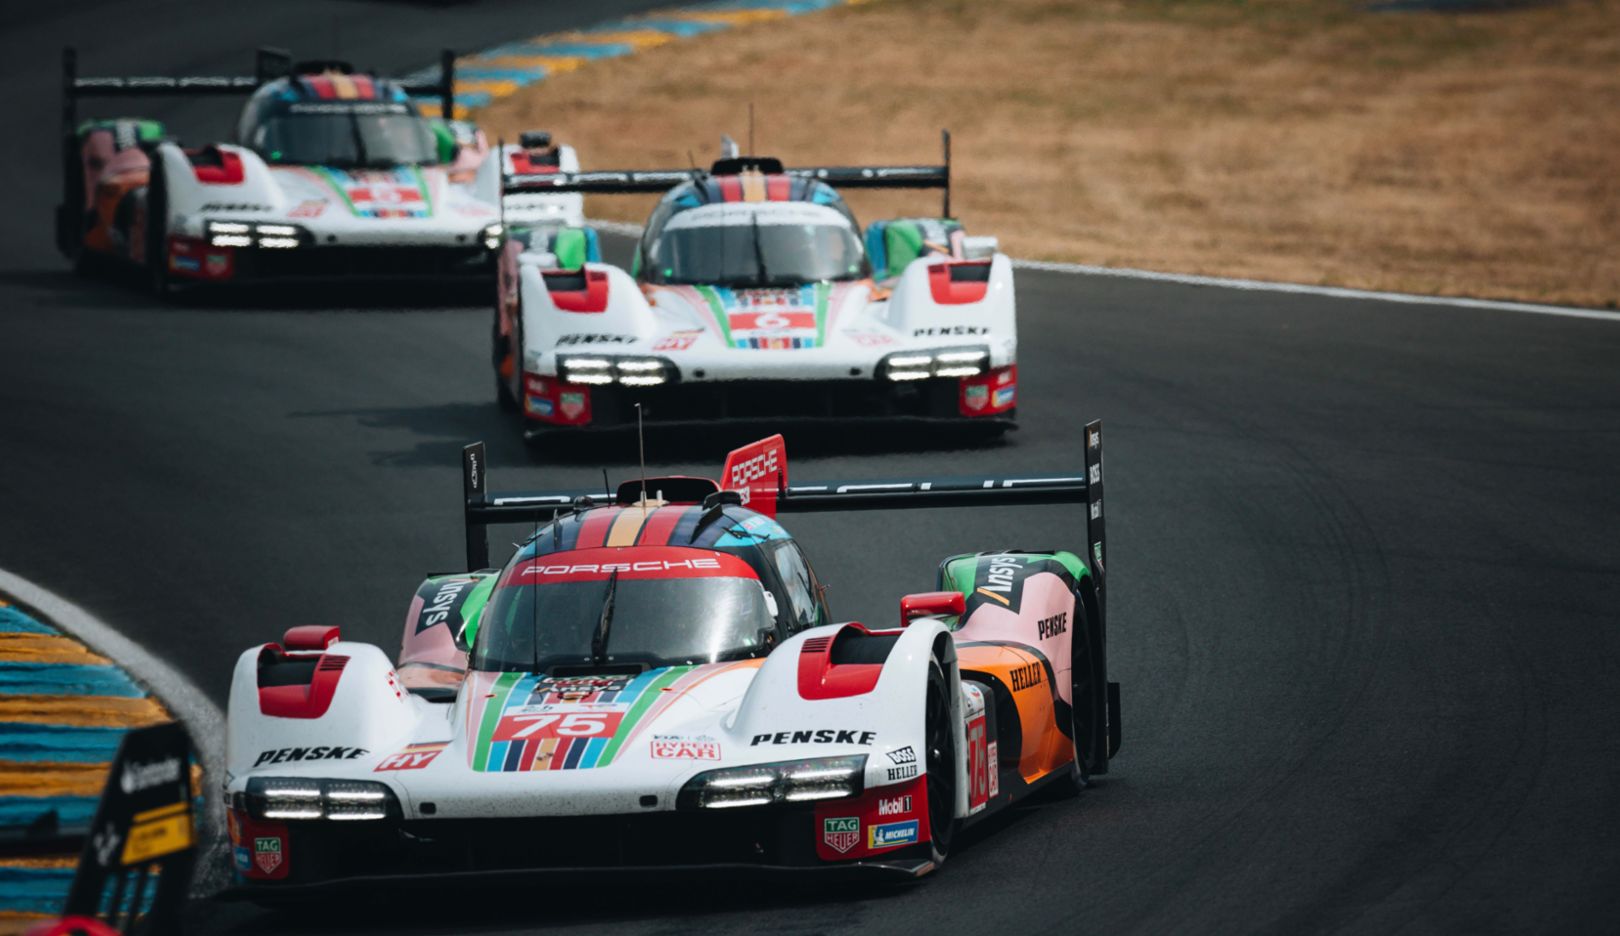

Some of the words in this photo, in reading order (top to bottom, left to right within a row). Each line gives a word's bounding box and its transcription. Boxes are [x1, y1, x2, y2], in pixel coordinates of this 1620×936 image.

[754, 312, 791, 329] 6
[914, 327, 991, 337] PENSKE
[731, 449, 778, 488] PORSCHE
[521, 558, 721, 576] PORSCHE
[1038, 612, 1067, 640] PENSKE
[1009, 661, 1042, 692] HELLER
[511, 713, 608, 738] 75
[751, 729, 877, 746] PENSKE
[253, 746, 370, 768] PENSKE
[381, 752, 434, 770] HY
[656, 747, 715, 758] CAR
[890, 747, 916, 765] BOSS
[970, 724, 986, 800] 75
[887, 765, 918, 781] HELLER
[879, 796, 903, 815] Mobil
[904, 796, 912, 812] 1
[828, 820, 857, 830] TAG
[884, 828, 915, 840] MICHELIN
[256, 840, 278, 851] TAG
[826, 832, 858, 850] HEUER
